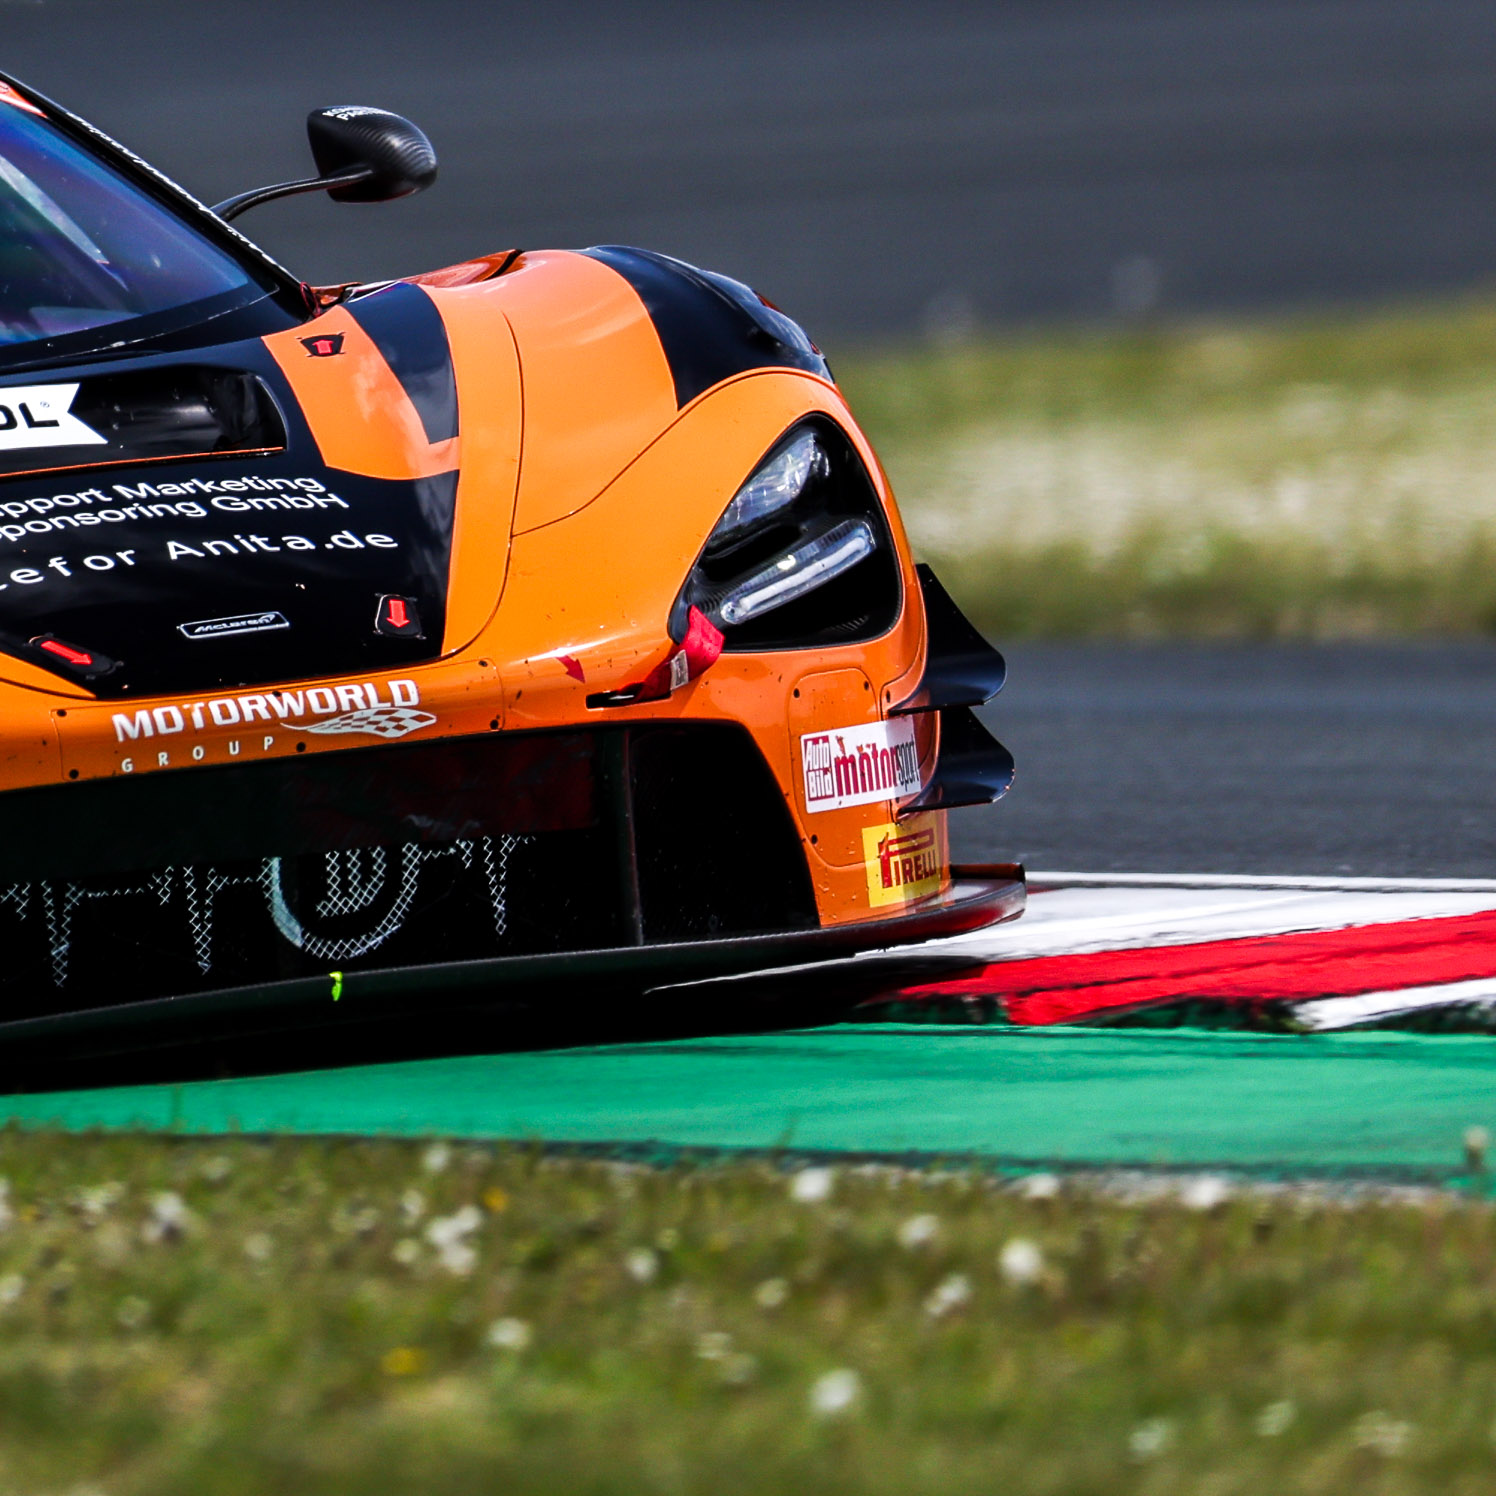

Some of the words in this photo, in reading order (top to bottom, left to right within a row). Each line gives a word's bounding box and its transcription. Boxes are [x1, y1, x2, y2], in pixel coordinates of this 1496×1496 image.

[112, 476, 326, 500] Marketing
[210, 493, 350, 512] GmbH
[166, 530, 399, 560] Anita.de
[112, 679, 420, 743] MOTORWORLD
[121, 736, 274, 773] GROUP
[878, 828, 937, 889] PIRELLI
